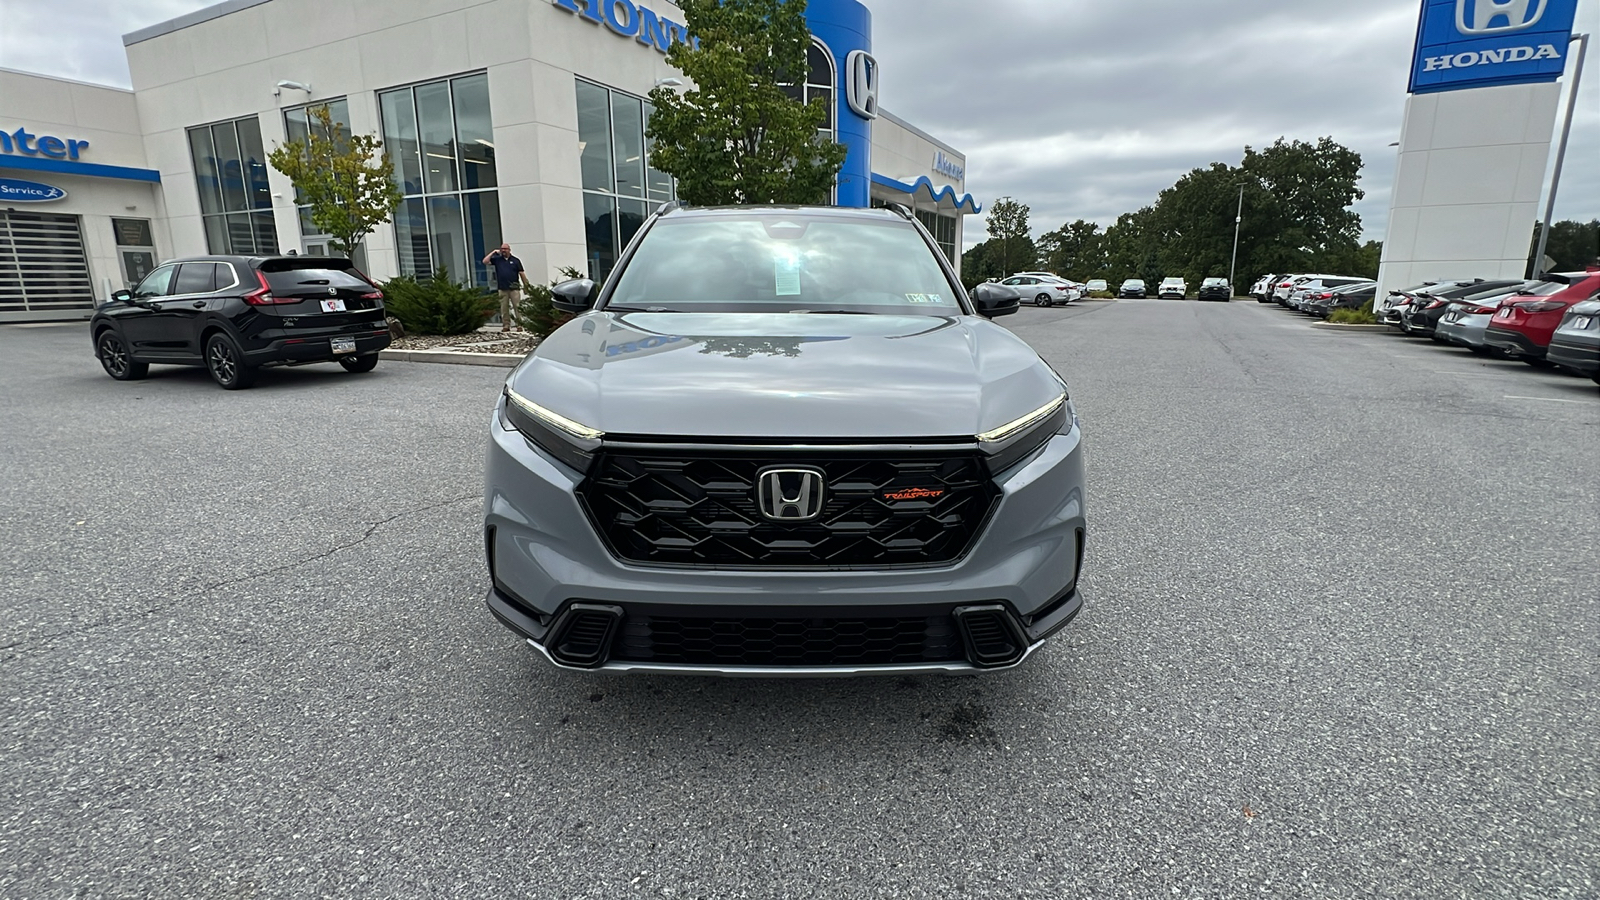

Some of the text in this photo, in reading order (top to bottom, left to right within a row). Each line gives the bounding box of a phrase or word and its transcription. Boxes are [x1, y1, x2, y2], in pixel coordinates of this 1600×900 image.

[1422, 44, 1561, 72] HONDA
[1, 185, 43, 196] Service
[884, 489, 943, 500] TRAILSPORT
